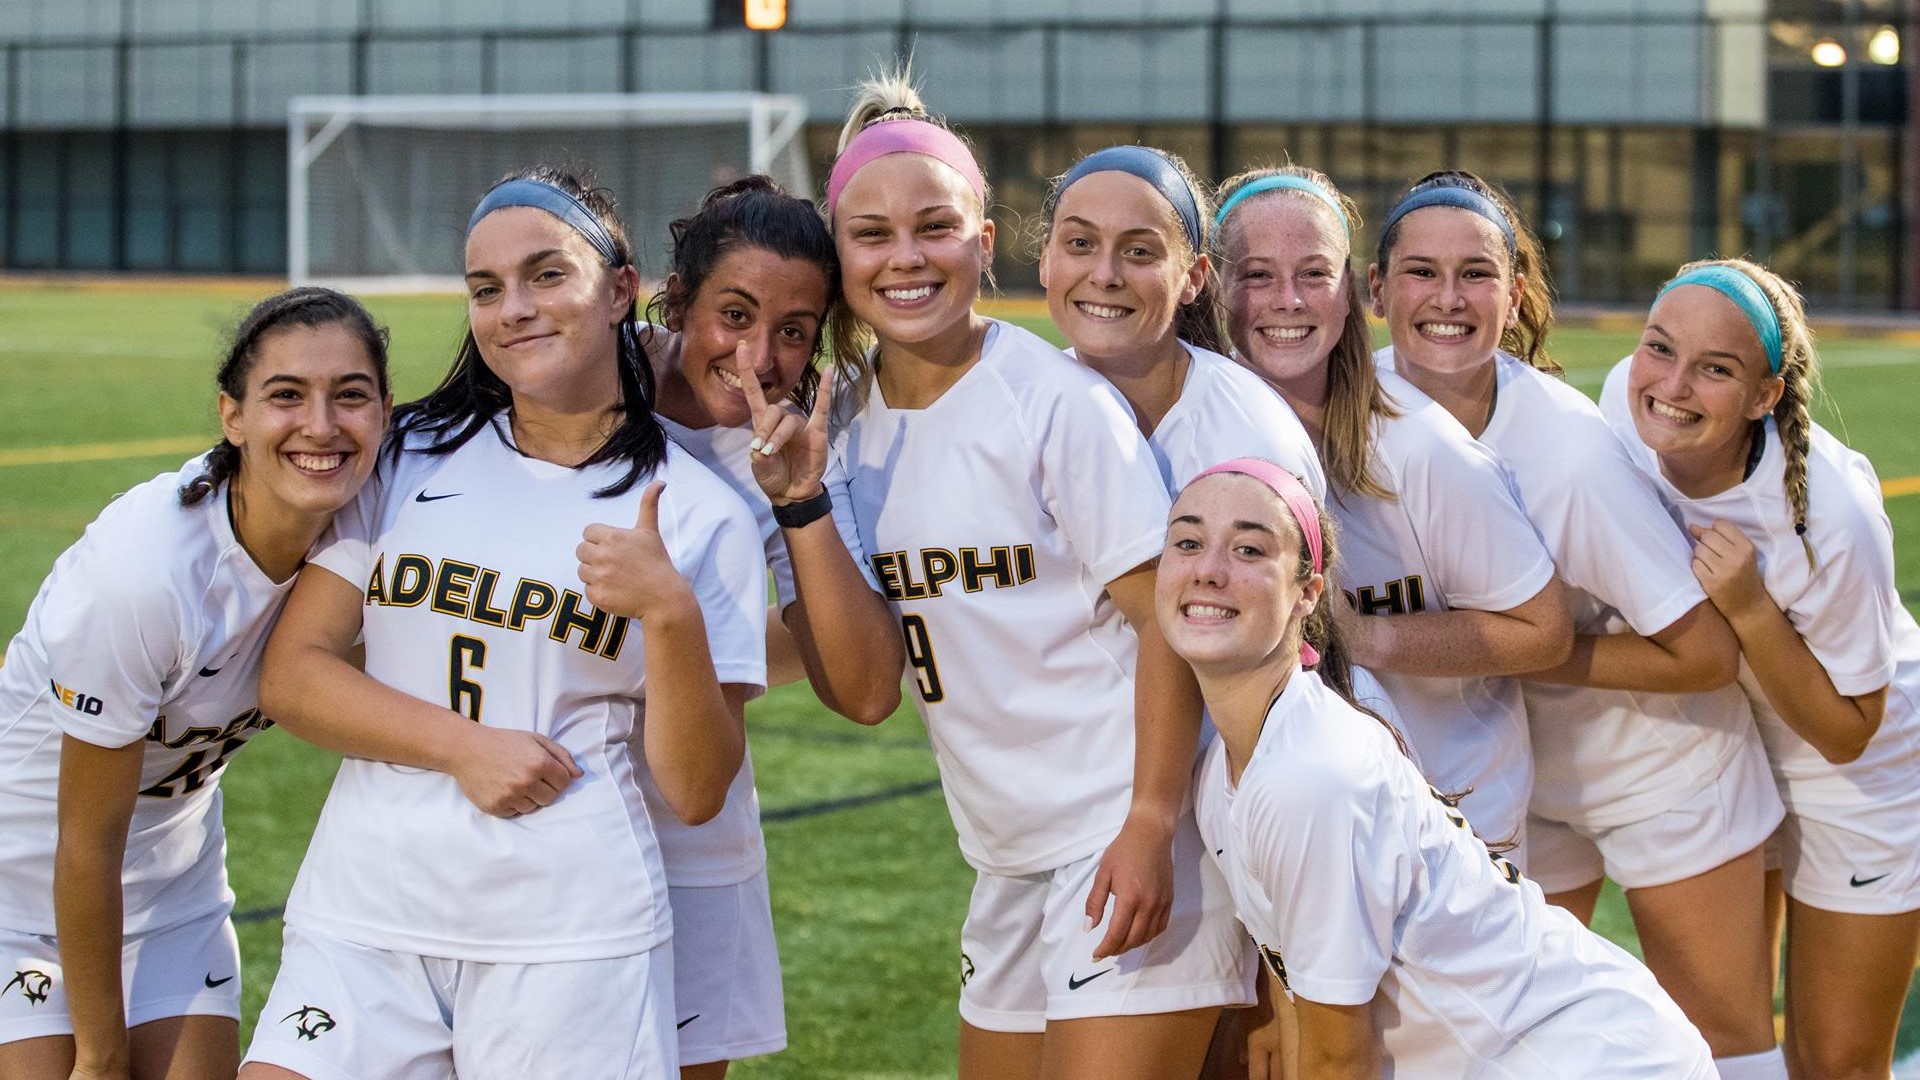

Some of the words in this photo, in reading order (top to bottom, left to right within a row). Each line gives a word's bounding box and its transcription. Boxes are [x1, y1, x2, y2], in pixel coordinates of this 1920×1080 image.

[366, 552, 631, 661] ADELPHI
[1344, 574, 1425, 616] HI
[450, 632, 488, 723] 6
[902, 611, 945, 704] 9
